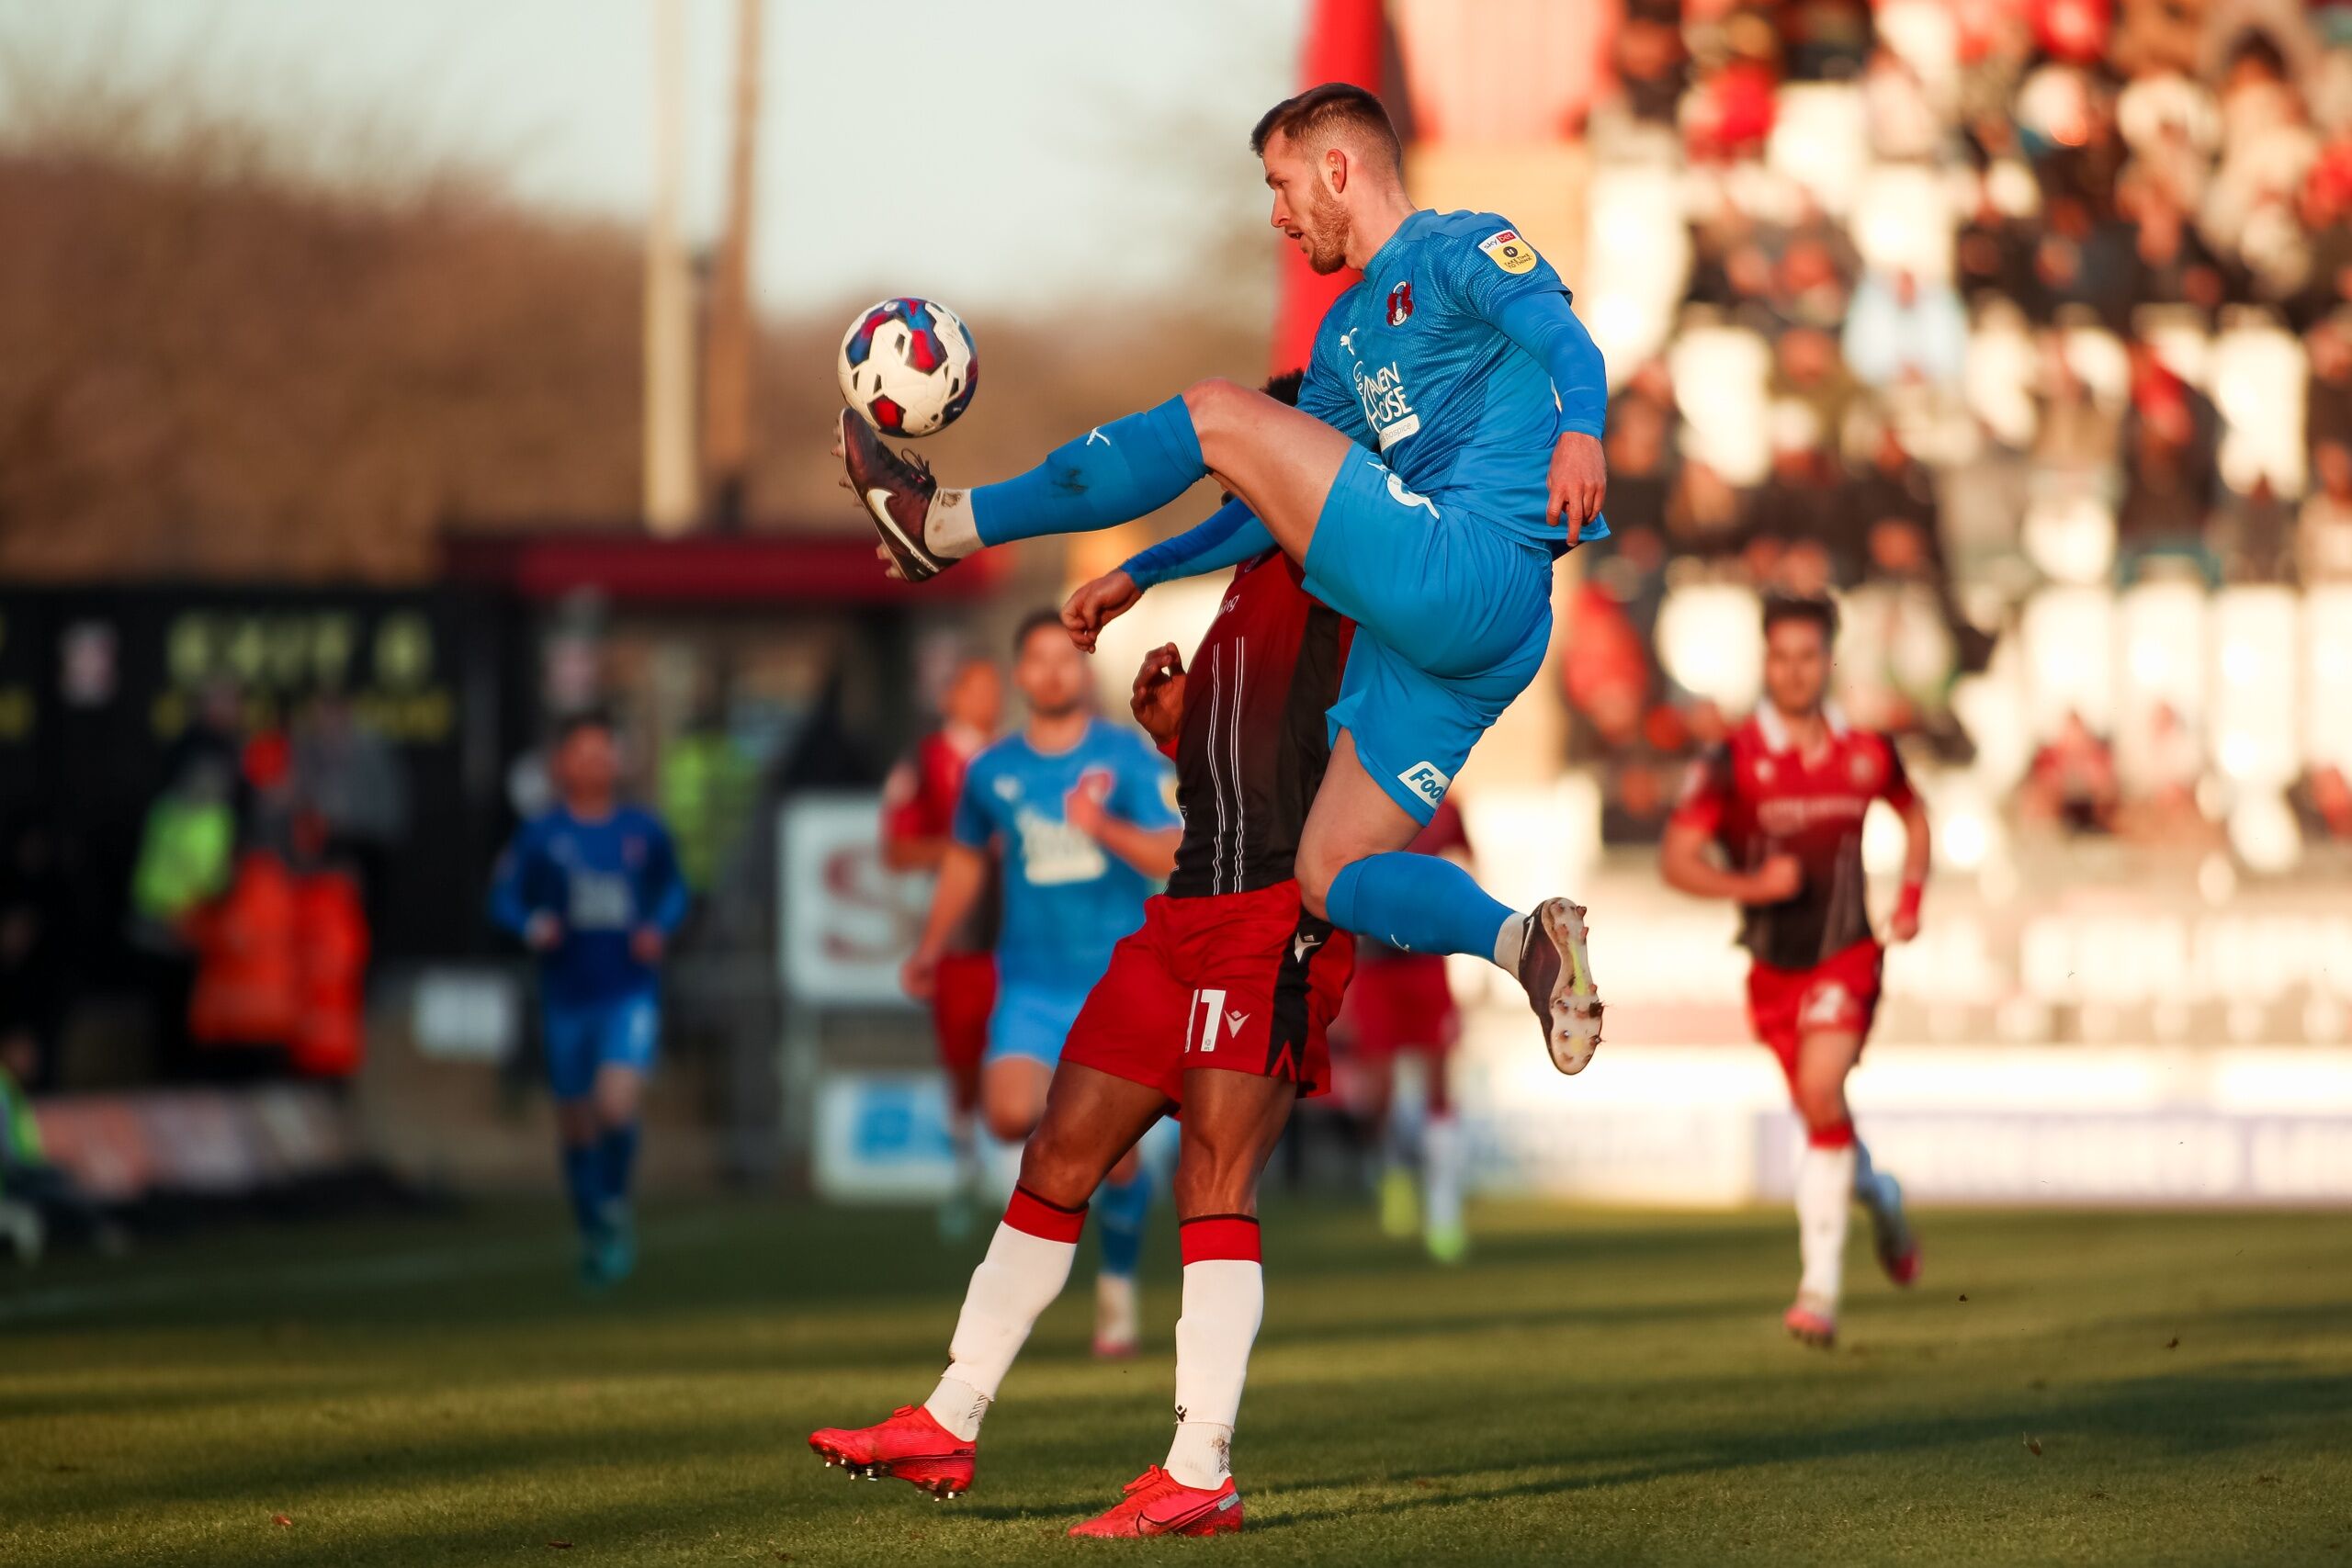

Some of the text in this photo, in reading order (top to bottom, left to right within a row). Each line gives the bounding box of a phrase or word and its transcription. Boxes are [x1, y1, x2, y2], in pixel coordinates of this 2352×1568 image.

[1484, 231, 1514, 249] sky bet
[1384, 423, 1412, 440] hospice
[1408, 768, 1447, 804] Foo
